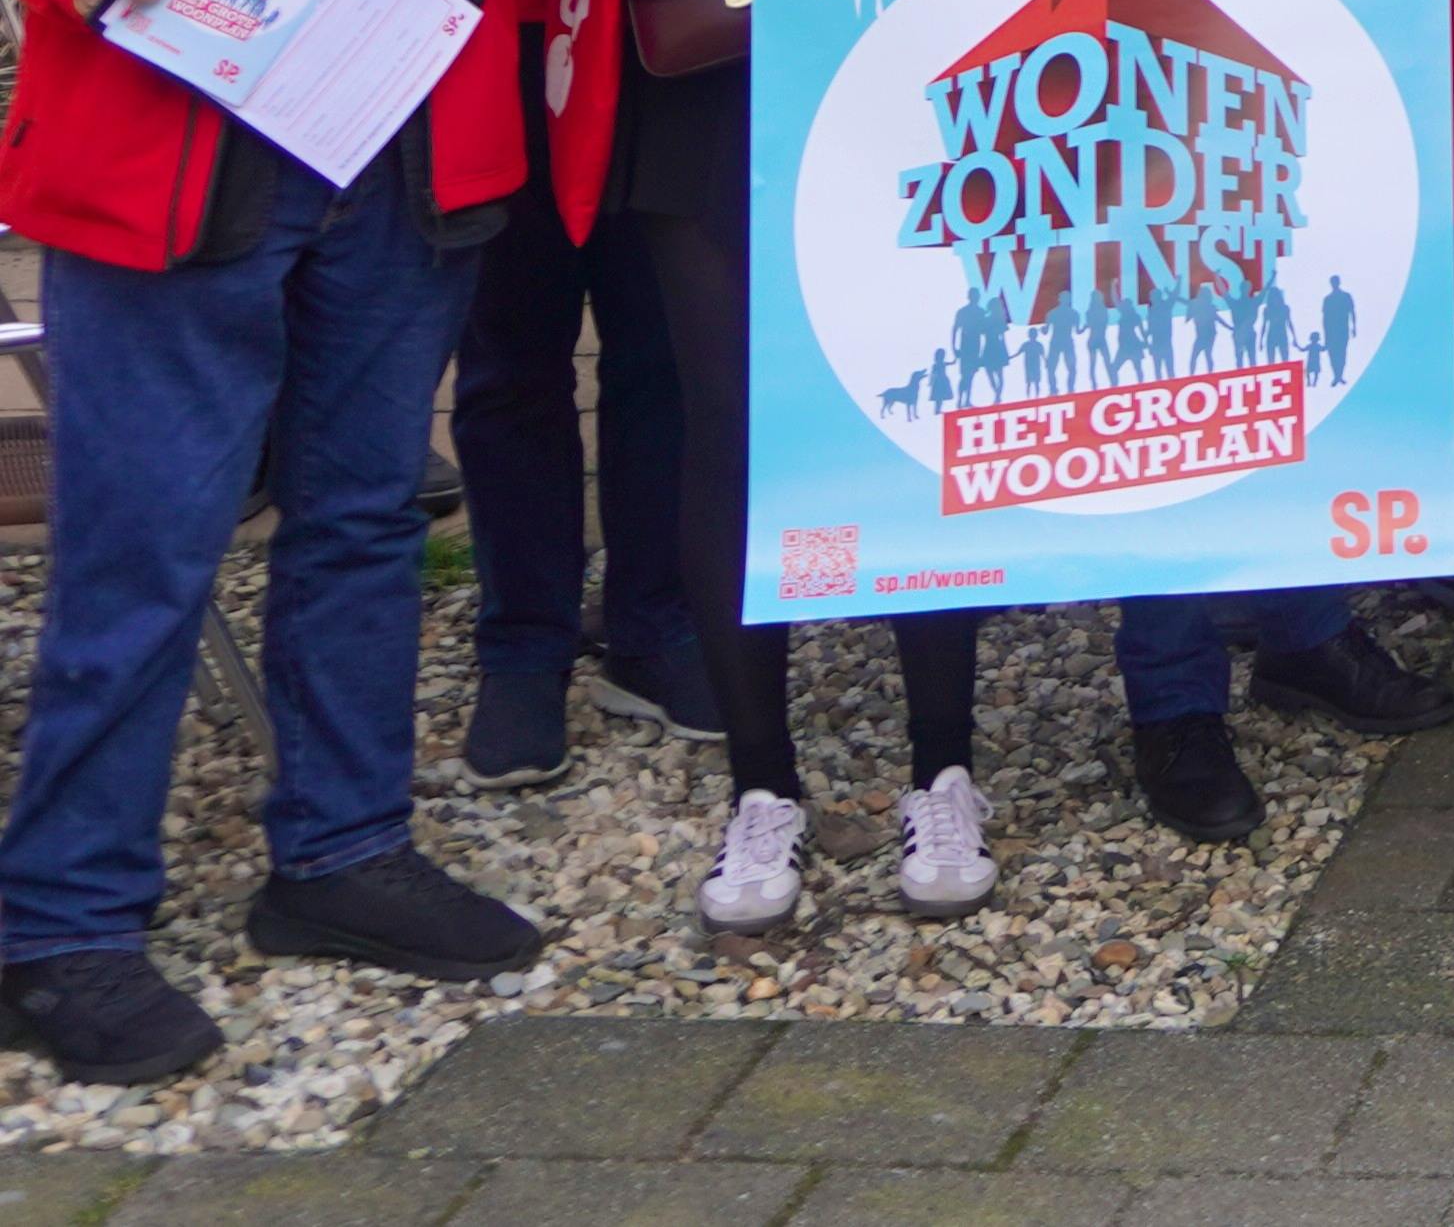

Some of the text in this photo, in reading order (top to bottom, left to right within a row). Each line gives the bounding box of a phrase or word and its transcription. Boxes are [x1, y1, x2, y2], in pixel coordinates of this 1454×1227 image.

[926, 20, 1311, 159] WONEN
[898, 123, 1308, 248] ZONDER
[953, 219, 1293, 326] WINST
[955, 370, 1292, 458] HET GROTE
[951, 416, 1297, 506] WOONPLAN
[1330, 489, 1428, 559] SP.
[874, 566, 1004, 594] sp.nl/wonen
